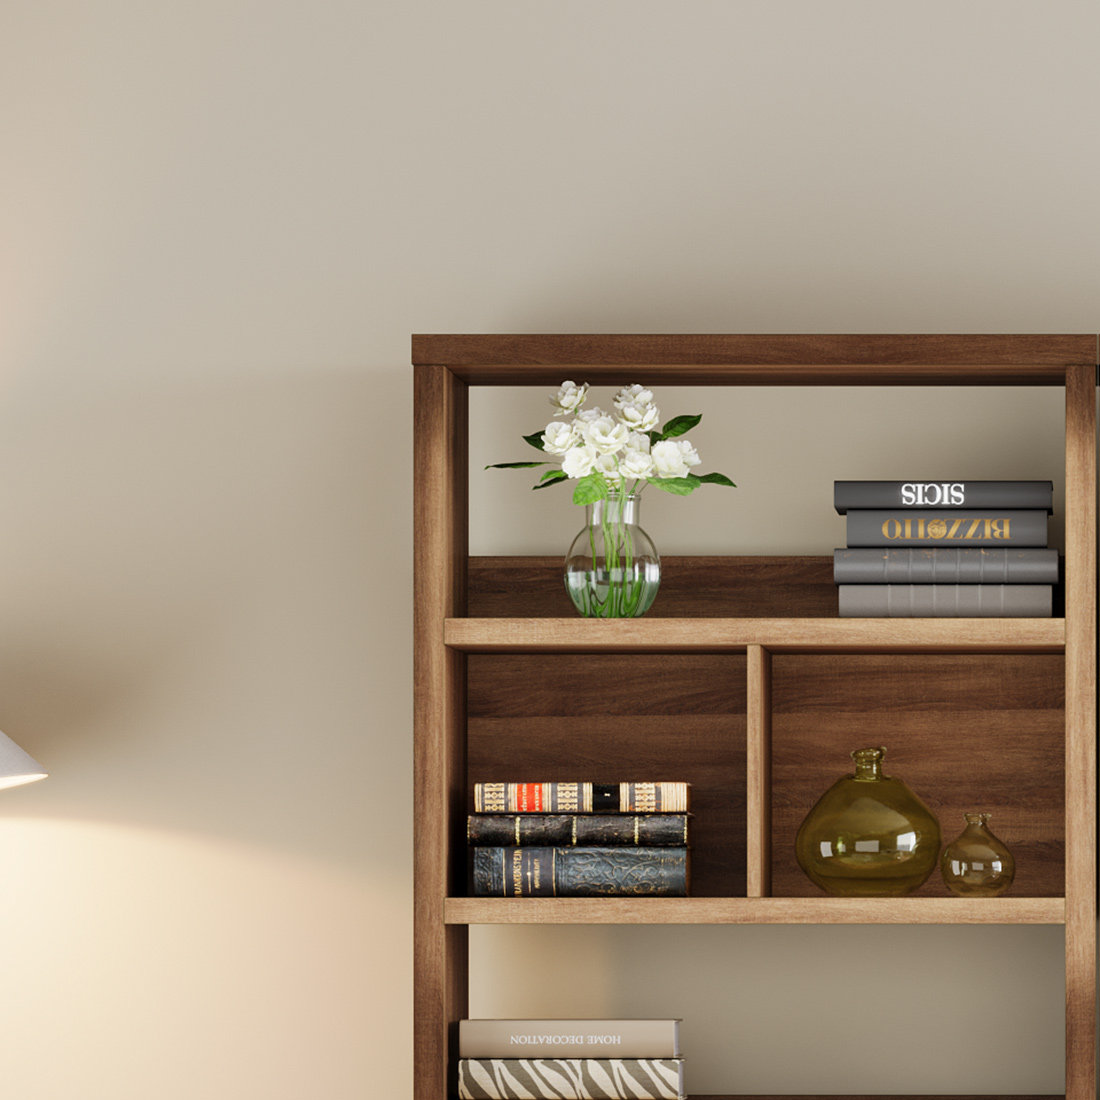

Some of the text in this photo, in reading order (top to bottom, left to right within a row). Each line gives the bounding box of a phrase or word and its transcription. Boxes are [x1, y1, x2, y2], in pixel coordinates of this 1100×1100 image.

[901, 483, 965, 505] SICIS
[513, 849, 522, 897] RANKENSTEIN
[510, 1035, 621, 1045] HOME DECORATION
